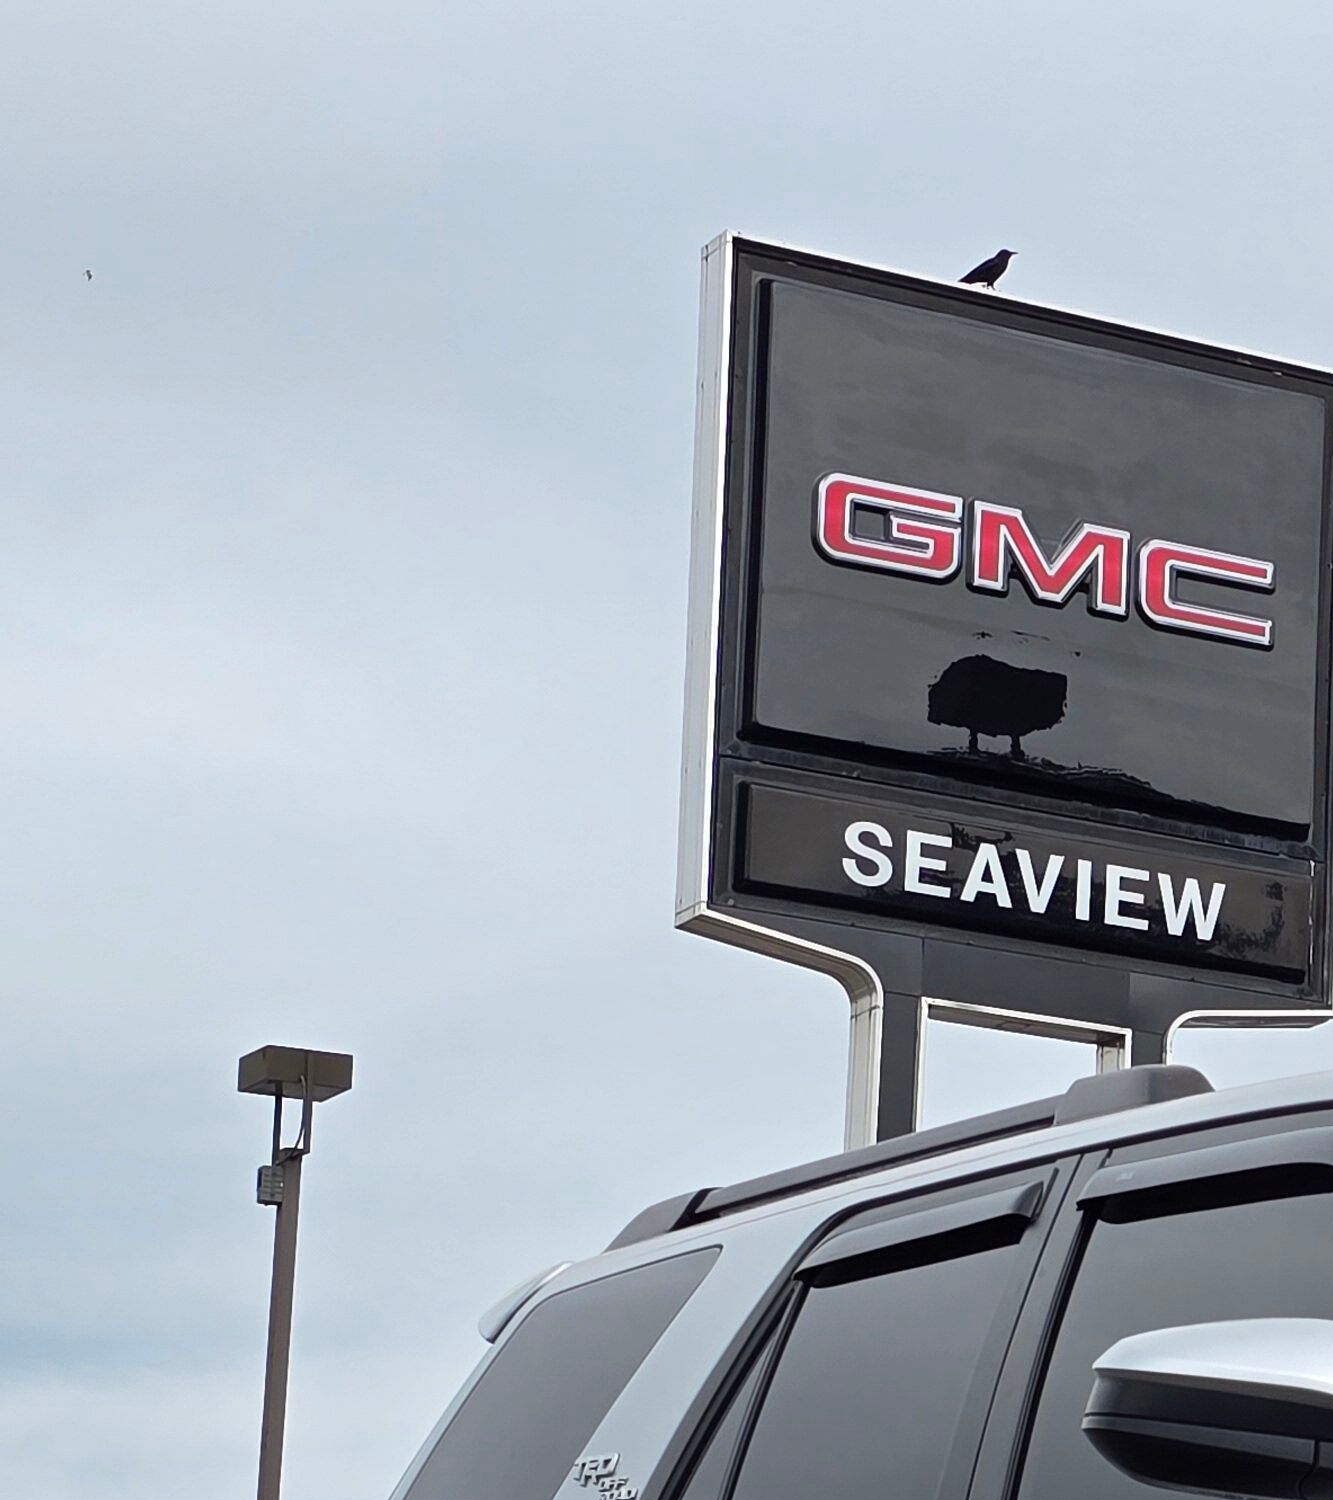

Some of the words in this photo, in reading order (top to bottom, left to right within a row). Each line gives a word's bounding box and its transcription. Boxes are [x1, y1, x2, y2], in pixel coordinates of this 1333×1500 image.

[816, 471, 1275, 646] GMC
[840, 821, 1227, 942] SEAVIEW
[573, 1452, 621, 1488] TRD
